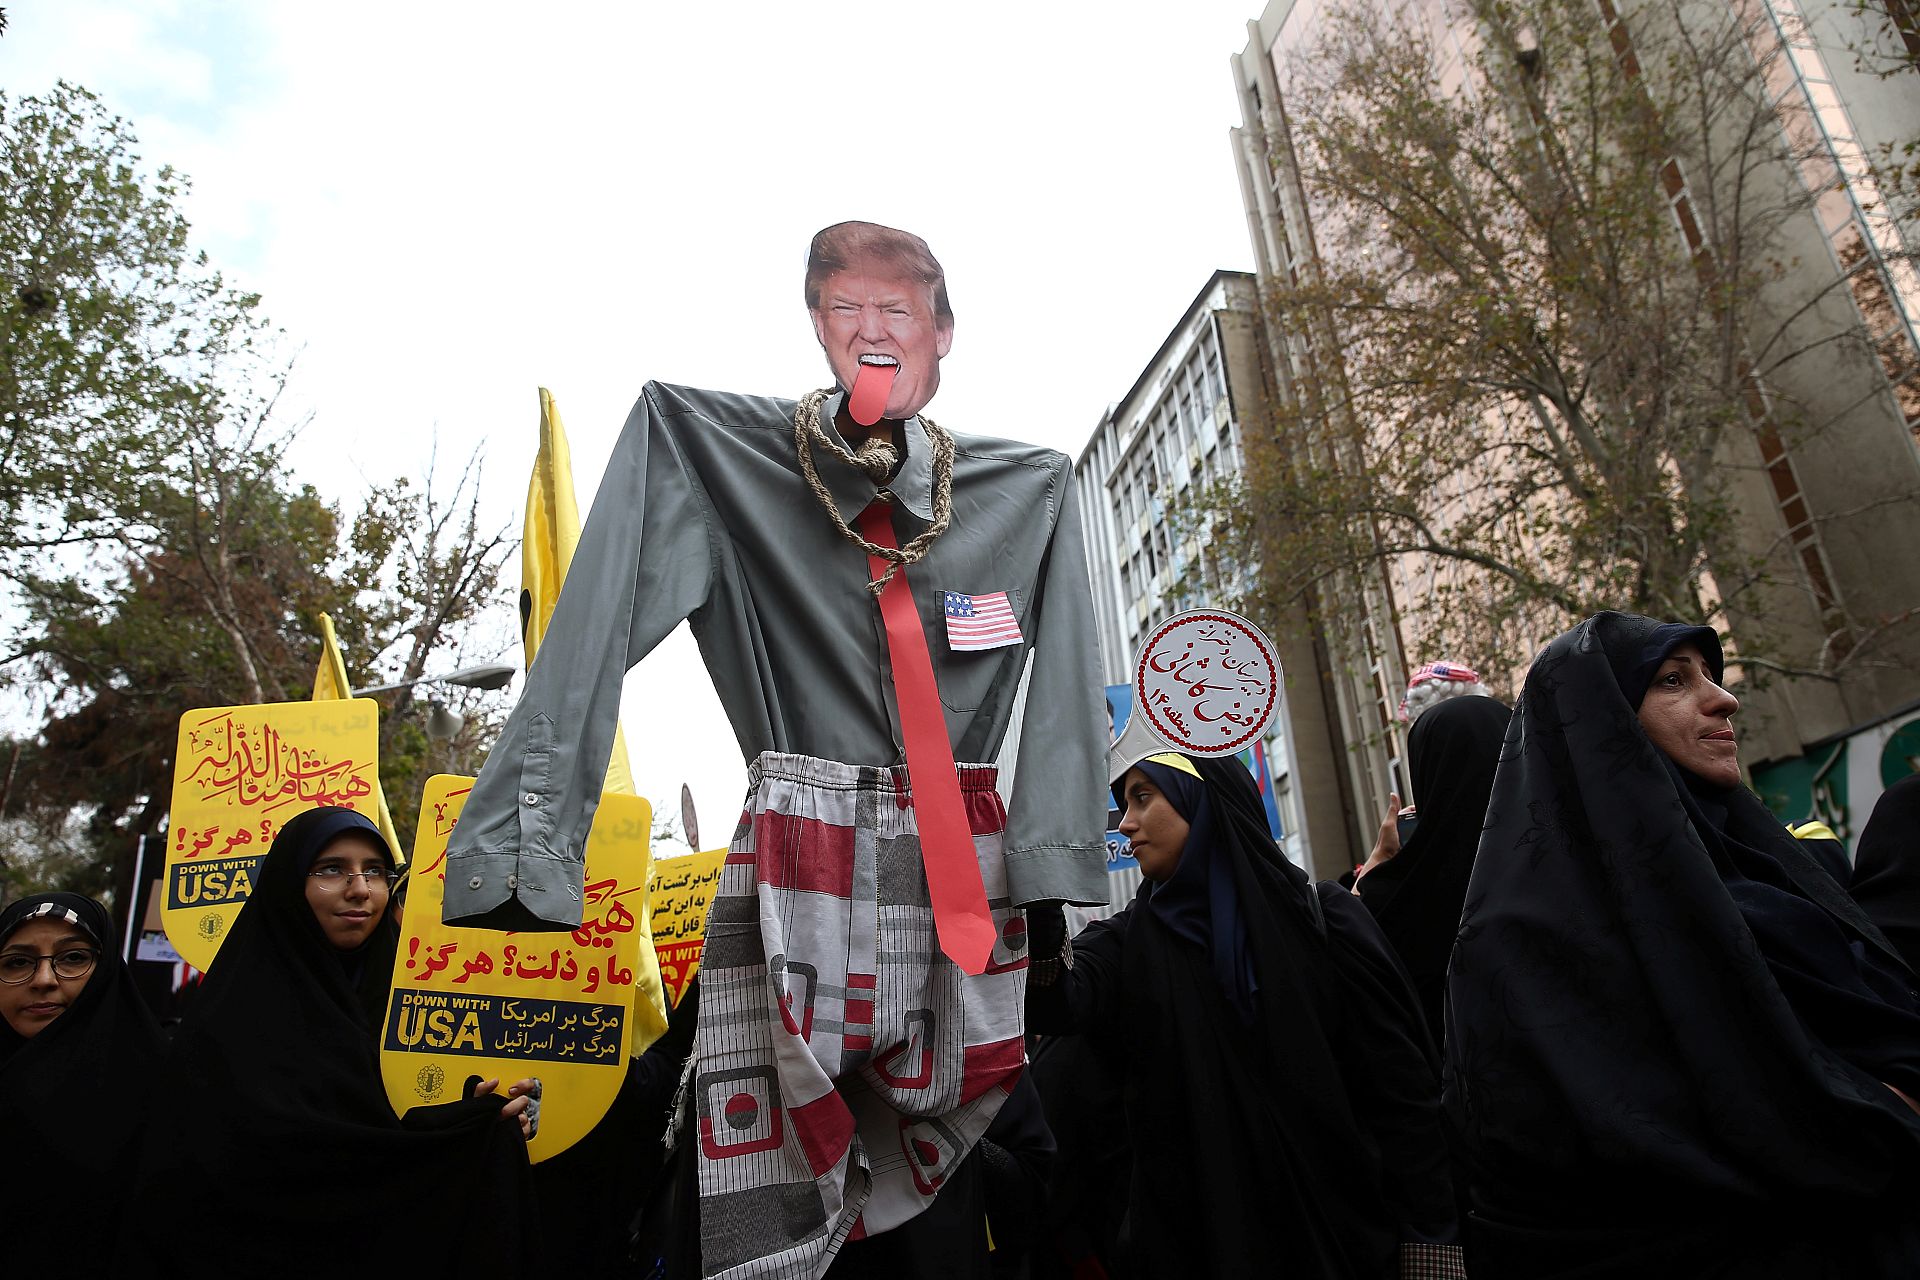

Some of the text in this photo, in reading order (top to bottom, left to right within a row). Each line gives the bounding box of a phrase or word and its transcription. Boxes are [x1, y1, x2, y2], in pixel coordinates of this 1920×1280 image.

[175, 825, 253, 858] هرگز!
[179, 859, 257, 875] DOWN WITH
[176, 869, 252, 904] USA
[405, 936, 494, 984] هرگز!
[607, 953, 633, 986] ما
[675, 945, 703, 962] WIT
[581, 965, 600, 994] و
[402, 993, 491, 1011] DOWN WITH
[501, 1001, 619, 1033] مرگ بر امریکا
[396, 1006, 484, 1050] USA
[494, 1030, 617, 1060] مرگ بر اسرائیل
